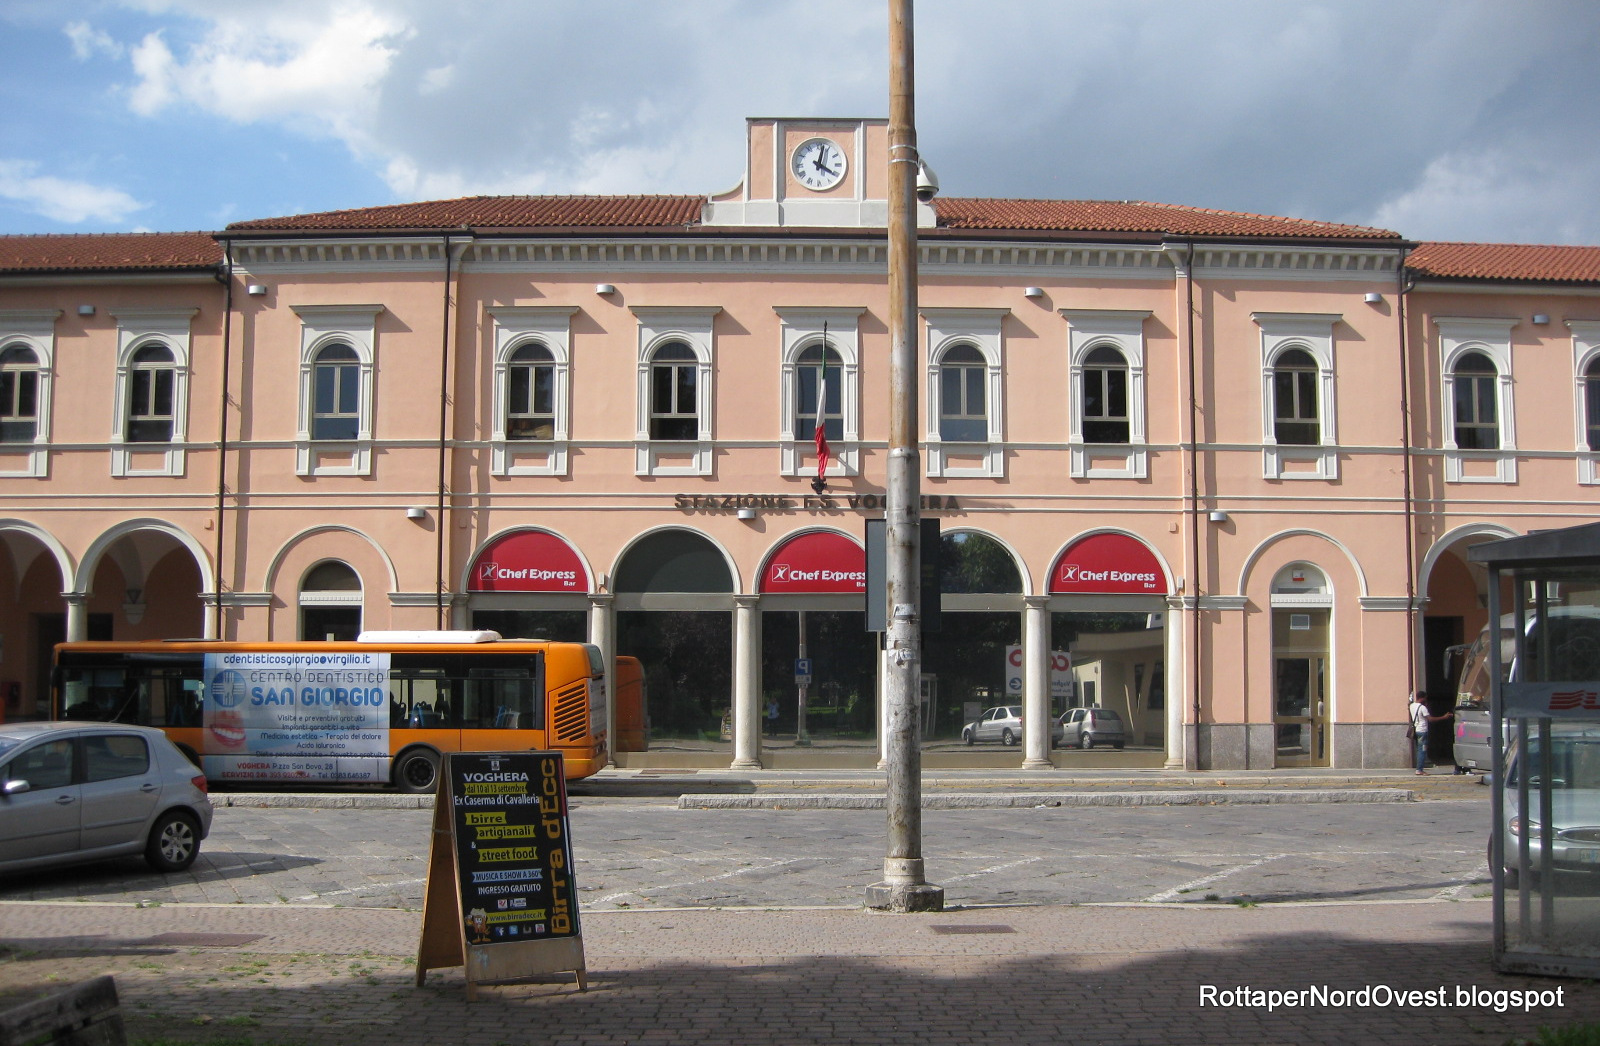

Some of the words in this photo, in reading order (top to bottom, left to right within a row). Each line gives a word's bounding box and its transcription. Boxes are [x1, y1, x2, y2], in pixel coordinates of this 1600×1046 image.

[674, 494, 789, 509] STAZIONE
[499, 568, 527, 578] Chef
[530, 568, 576, 580] Express
[790, 570, 820, 580] Chef
[1080, 570, 1108, 580] Chef
[1110, 570, 1155, 582] Express
[224, 654, 370, 666] cdentisticosgiorgio@virgilio.it
[250, 672, 302, 683] CENTRO
[308, 672, 384, 684] DENTISTICO
[251, 686, 294, 706] SAN
[300, 686, 384, 706] GIORGIO
[277, 714, 296, 722] Visite
[304, 714, 338, 724] preventivi
[340, 714, 366, 723] gratuiti
[260, 732, 290, 740] Medicina
[326, 733, 350, 741] Terapia
[236, 762, 270, 770] VOGHERA
[292, 762, 304, 770] San
[464, 772, 530, 782] VOGHERA
[466, 786, 476, 794] dal
[484, 784, 490, 792] al
[490, 784, 497, 792] 13
[498, 783, 525, 792] settembre
[454, 796, 463, 805] Ex
[464, 796, 496, 805] Caserma
[496, 794, 504, 804] di
[504, 794, 540, 804] Cavalleria
[470, 814, 502, 824] birre
[480, 826, 530, 839] artigianali
[482, 850, 510, 860] street
[512, 847, 534, 860] food
[476, 872, 498, 880] MUSICA
[504, 871, 522, 879] SHOW
[478, 885, 510, 895] INGRESSO
[510, 884, 542, 893] GRATUITO
[549, 848, 570, 934] Birra
[490, 912, 542, 922] www.birradecc.it
